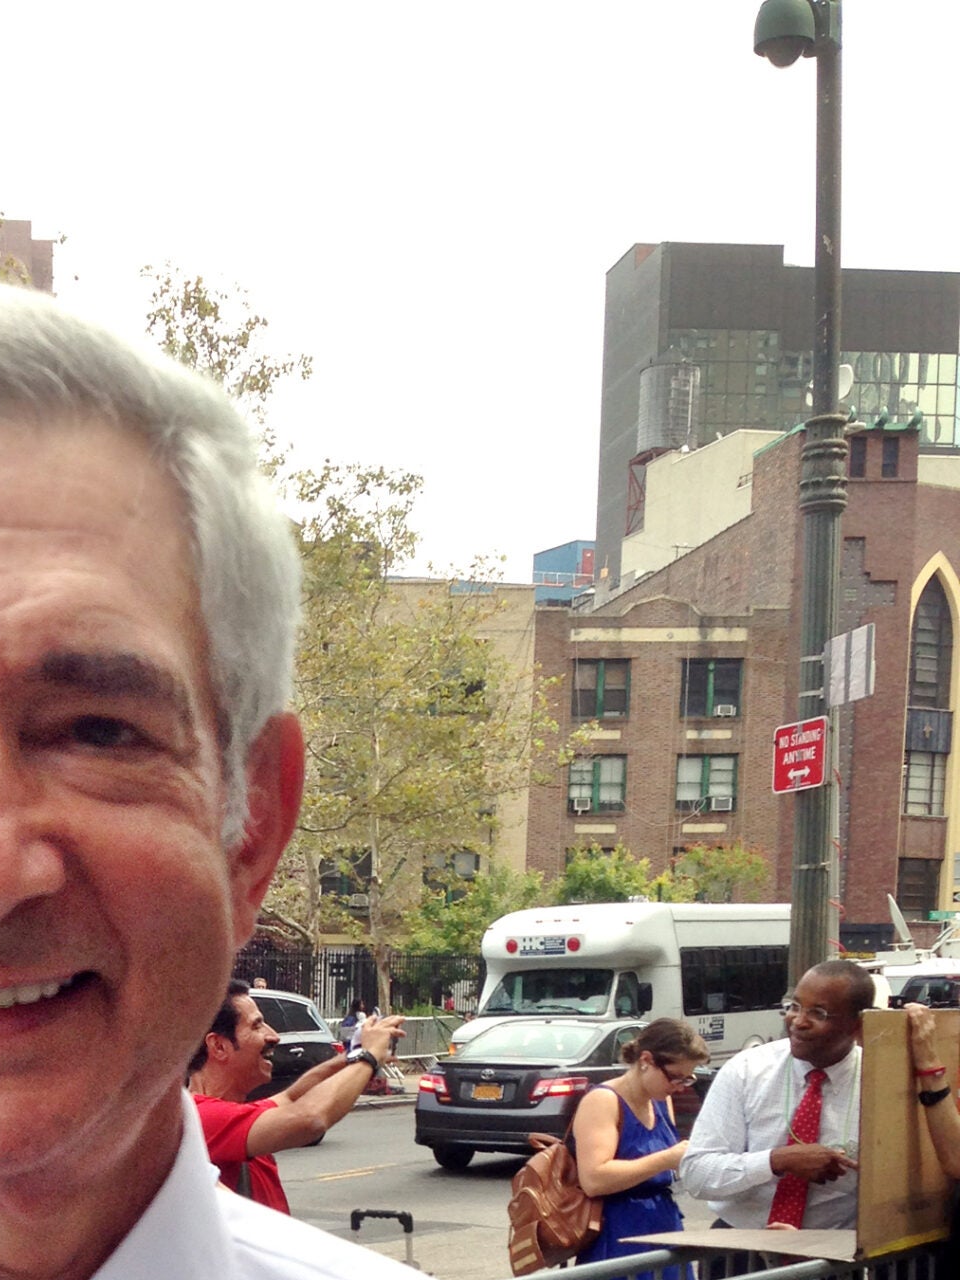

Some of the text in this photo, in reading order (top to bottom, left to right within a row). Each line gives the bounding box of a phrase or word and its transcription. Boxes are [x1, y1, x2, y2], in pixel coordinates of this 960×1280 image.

[779, 728, 822, 749] NO STANDING
[782, 746, 816, 765] ANYTIME
